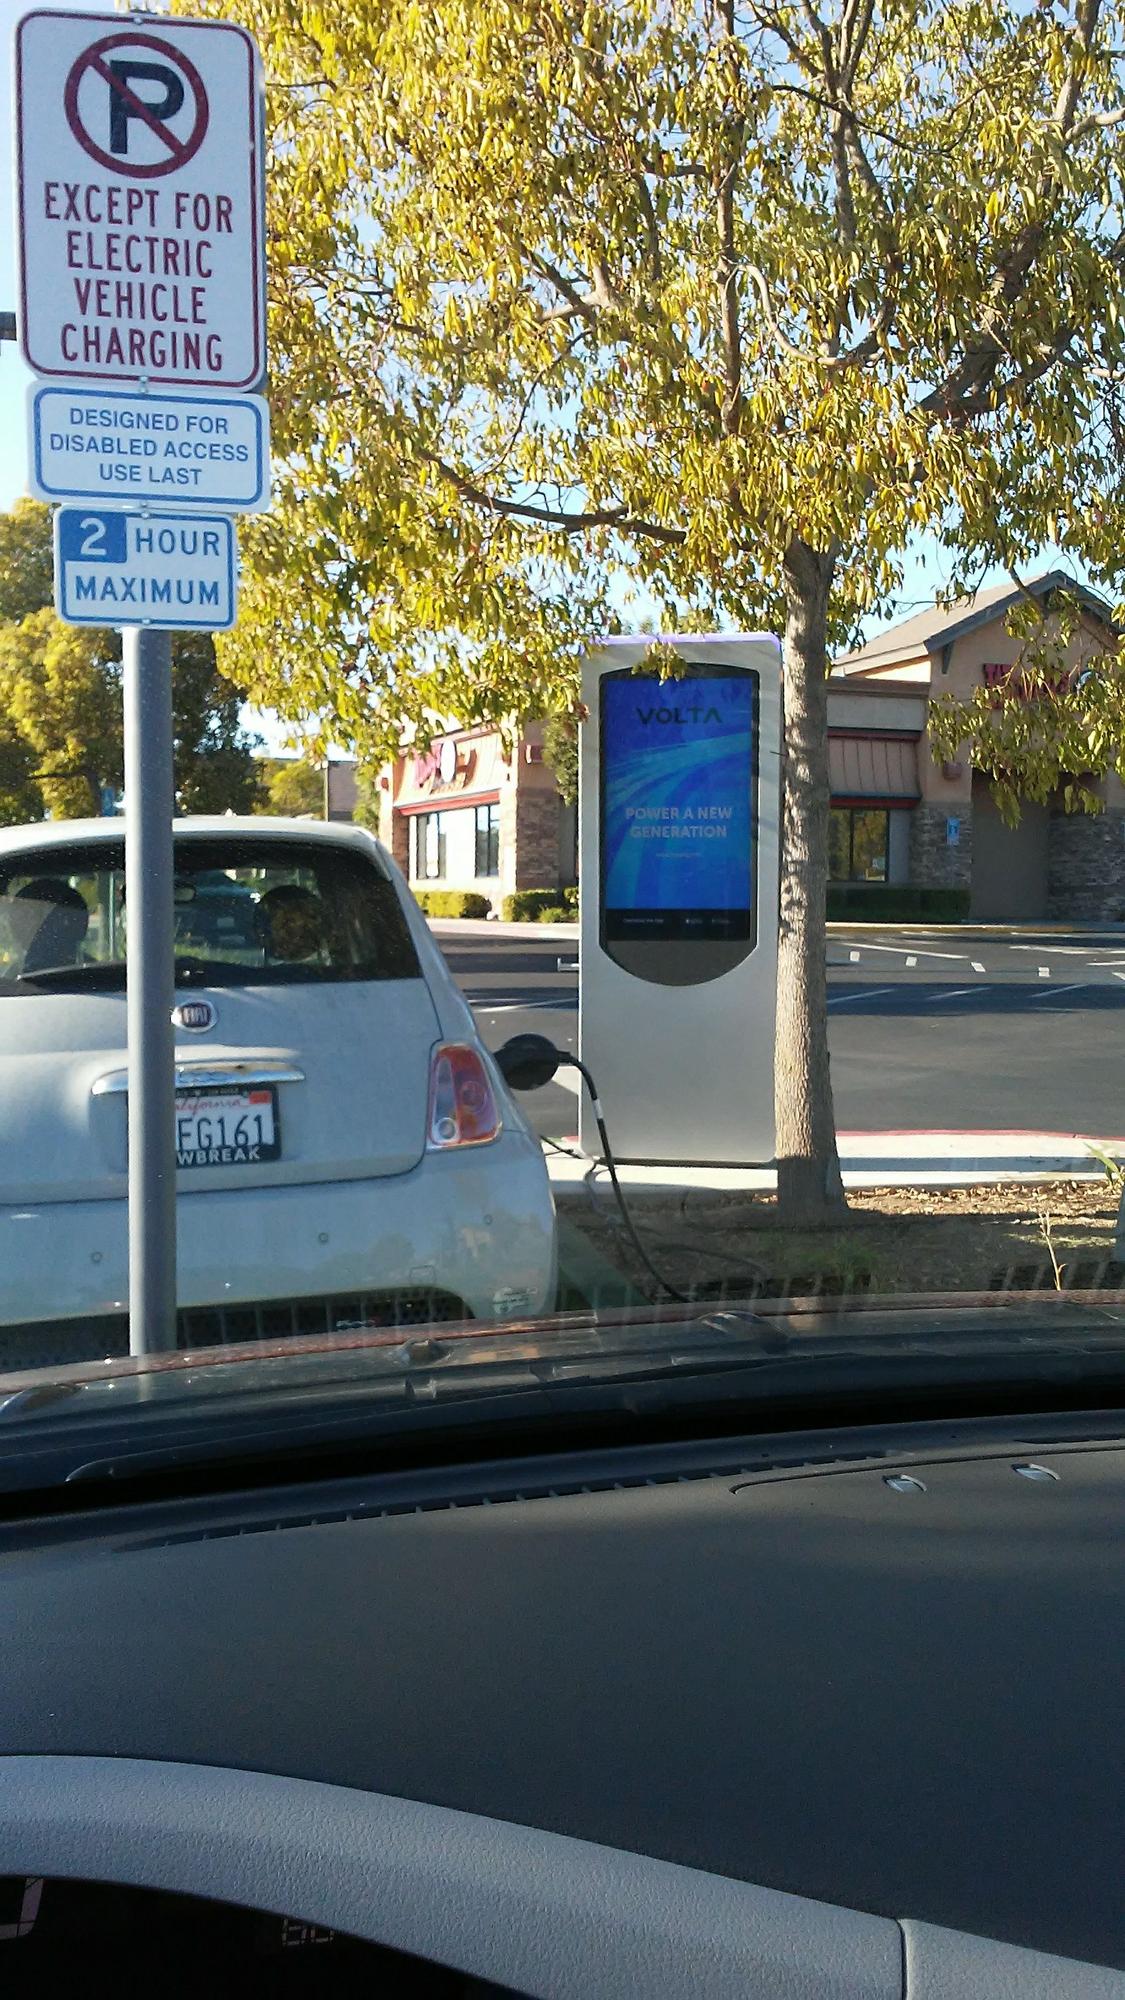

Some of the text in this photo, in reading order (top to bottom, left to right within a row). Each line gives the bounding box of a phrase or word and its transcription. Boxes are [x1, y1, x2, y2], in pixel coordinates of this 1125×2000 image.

[43, 181, 234, 234] EXCEPT FOR
[66, 230, 214, 279] ELECTRIC
[73, 277, 208, 325] VEHICLE
[60, 323, 223, 372] CHARGING
[69, 407, 229, 435] DESIGNED FOR
[50, 433, 249, 462] DISABLED ACCESS
[99, 463, 202, 486] USE LAST
[79, 517, 220, 556] 2 HOUR
[74, 575, 219, 606] MAXIMUM
[636, 706, 723, 725] VOLTA
[625, 806, 733, 821] POWER A NEW
[630, 825, 727, 839] GENERATION
[176, 1098, 241, 1115] alifornia
[178, 1114, 263, 1150] FG161
[176, 1146, 260, 1166] WBREAK
